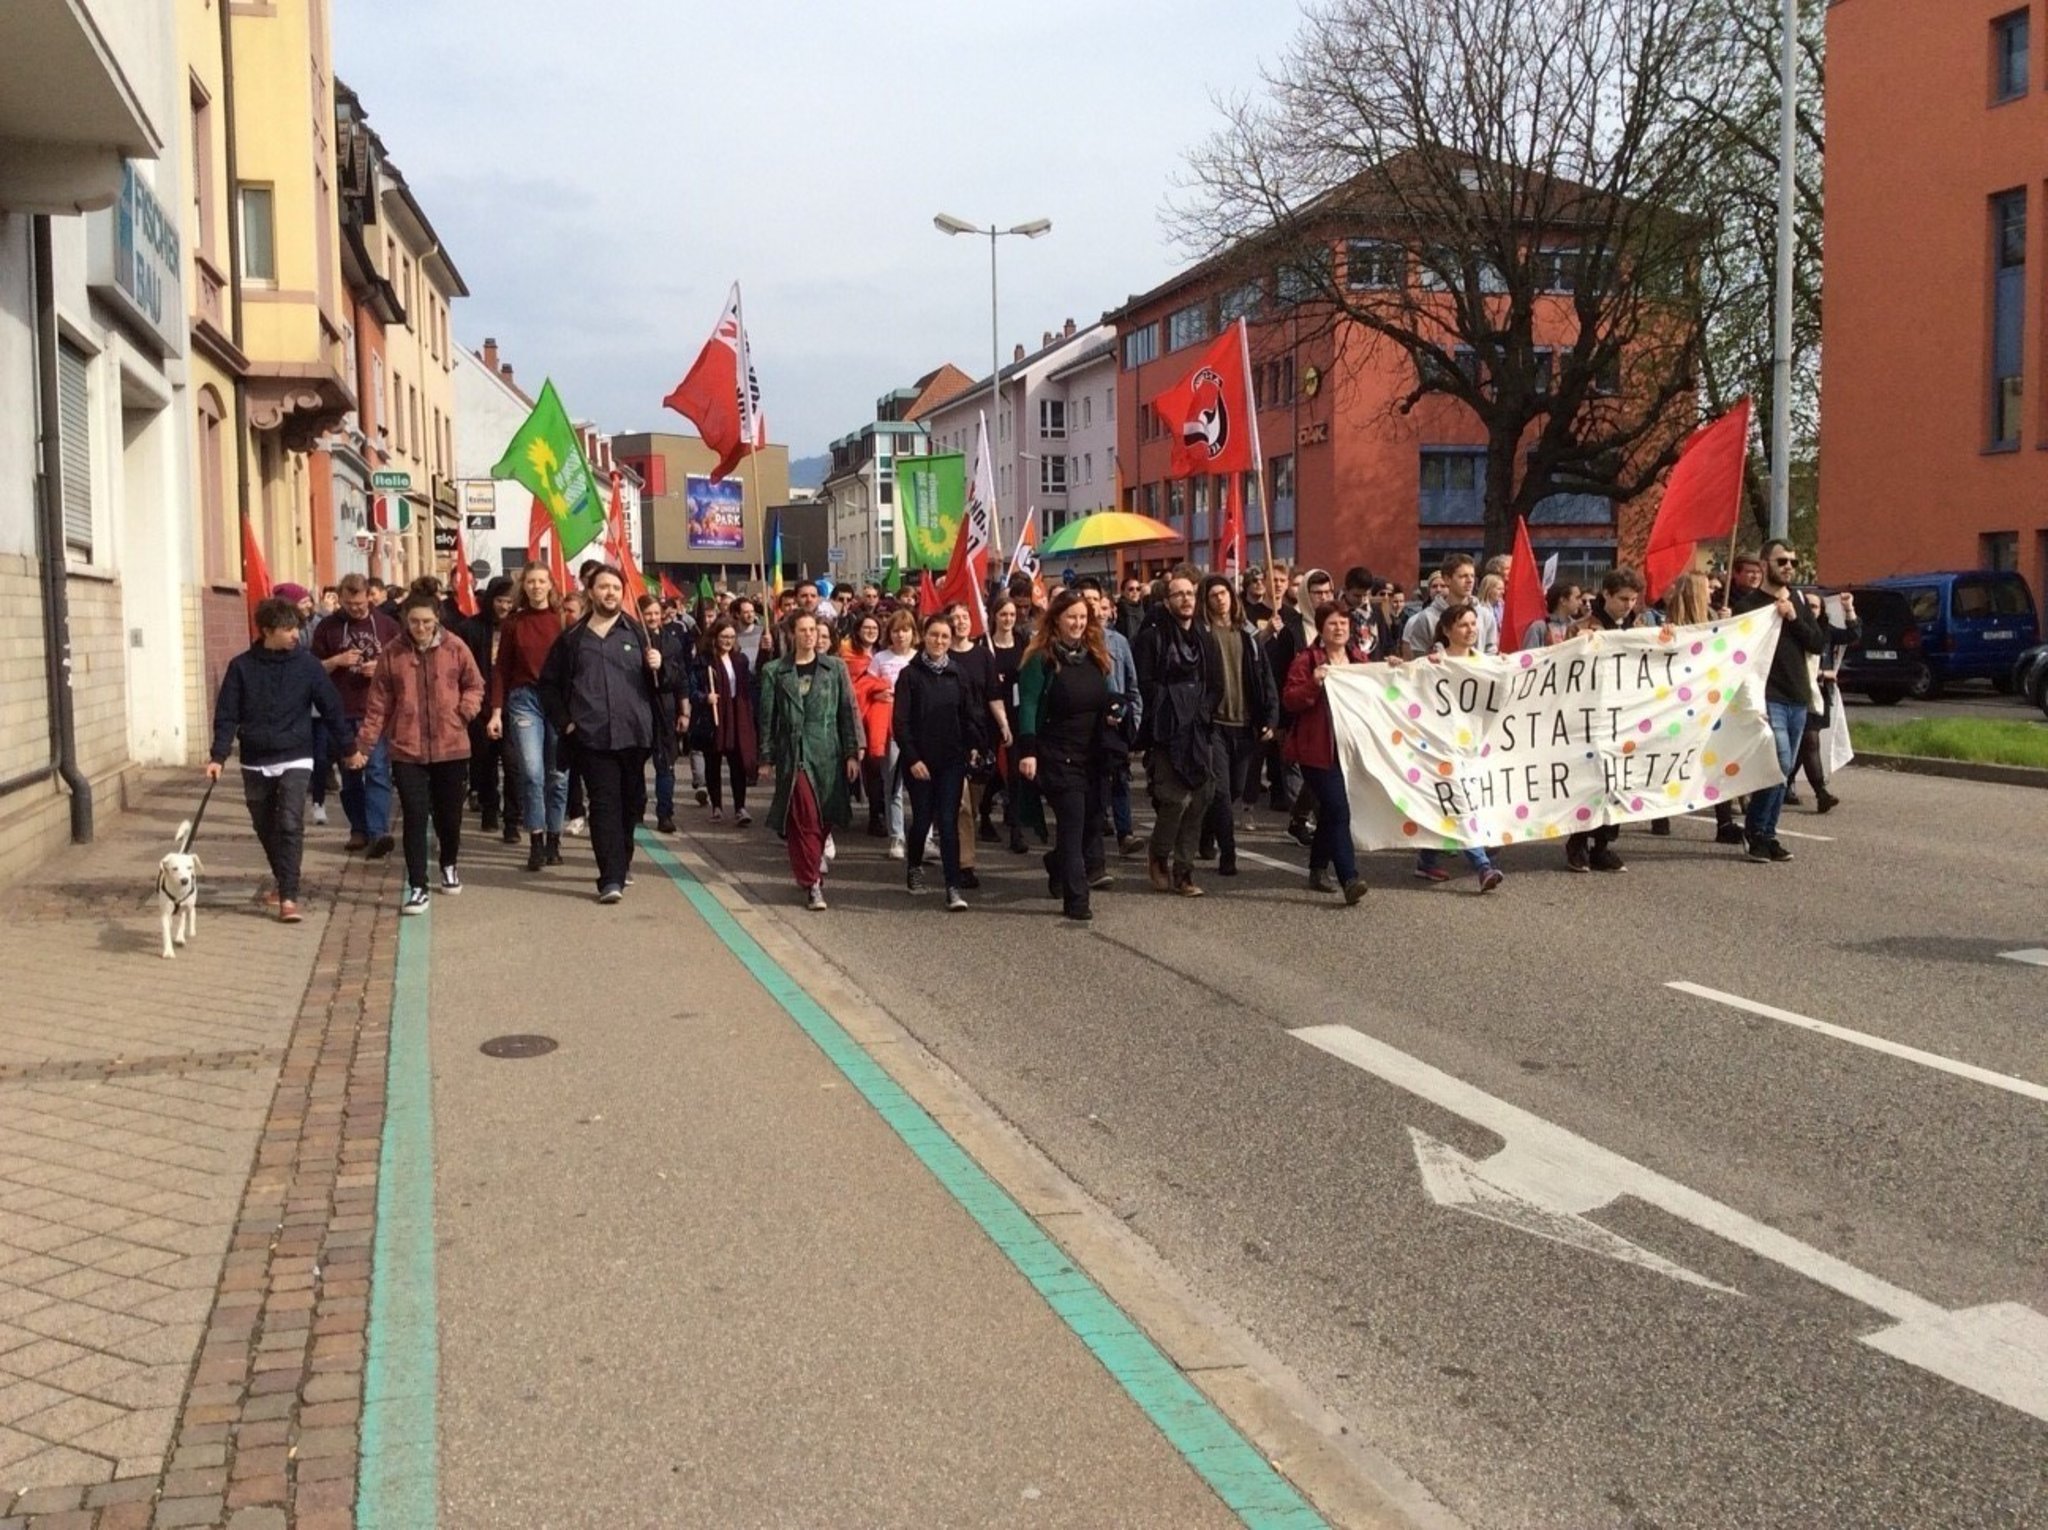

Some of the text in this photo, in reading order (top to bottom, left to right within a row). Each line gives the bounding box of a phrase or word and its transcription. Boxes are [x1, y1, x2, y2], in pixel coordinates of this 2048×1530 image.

[134, 171, 181, 283] FISCHER
[135, 250, 162, 325] BAU
[374, 475, 410, 487] Italia
[435, 532, 457, 546] sky
[1435, 649, 1679, 717] SOLIDARITÄT
[1501, 707, 1623, 752] STATT
[1603, 748, 1696, 794] HETZE
